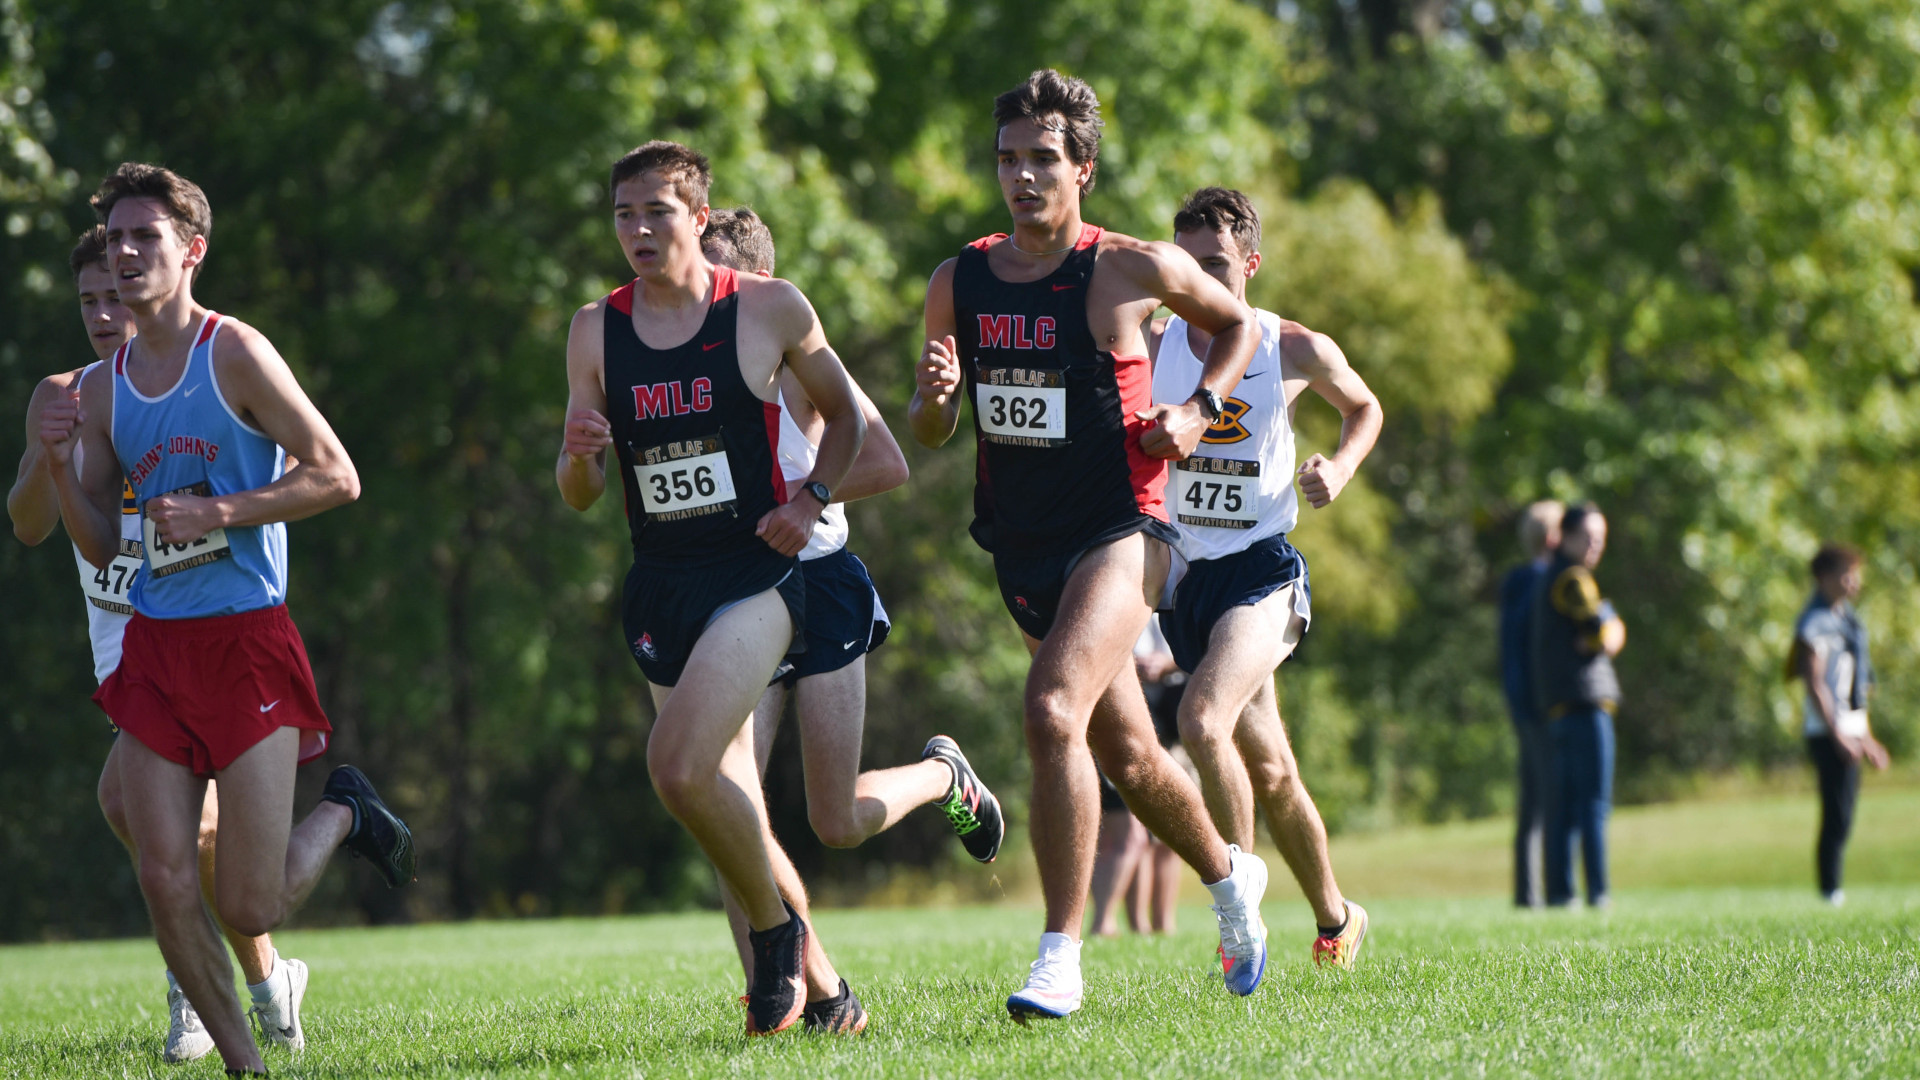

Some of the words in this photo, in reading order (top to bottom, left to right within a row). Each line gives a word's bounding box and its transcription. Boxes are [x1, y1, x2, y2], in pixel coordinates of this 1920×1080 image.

[977, 314, 1056, 349] MLC
[990, 369, 1010, 385] ST.
[1012, 368, 1046, 388] OLAF
[631, 376, 713, 421] MLC
[989, 395, 1047, 429] 362
[645, 446, 667, 465] ST.
[668, 440, 703, 459] OLAF
[990, 434, 1052, 448] INVITATIONAL
[131, 443, 164, 486] SAINT
[168, 436, 220, 463] JOHN'S
[1189, 458, 1208, 472] ST.
[1211, 459, 1243, 476] OLAF
[650, 466, 716, 505] 356
[1185, 481, 1243, 513] 475
[656, 503, 725, 522] INVITATIONAL
[1180, 515, 1245, 529] INVITATIONAL
[160, 551, 218, 577] INVITATIONAL
[90, 597, 135, 616] INVITATION
